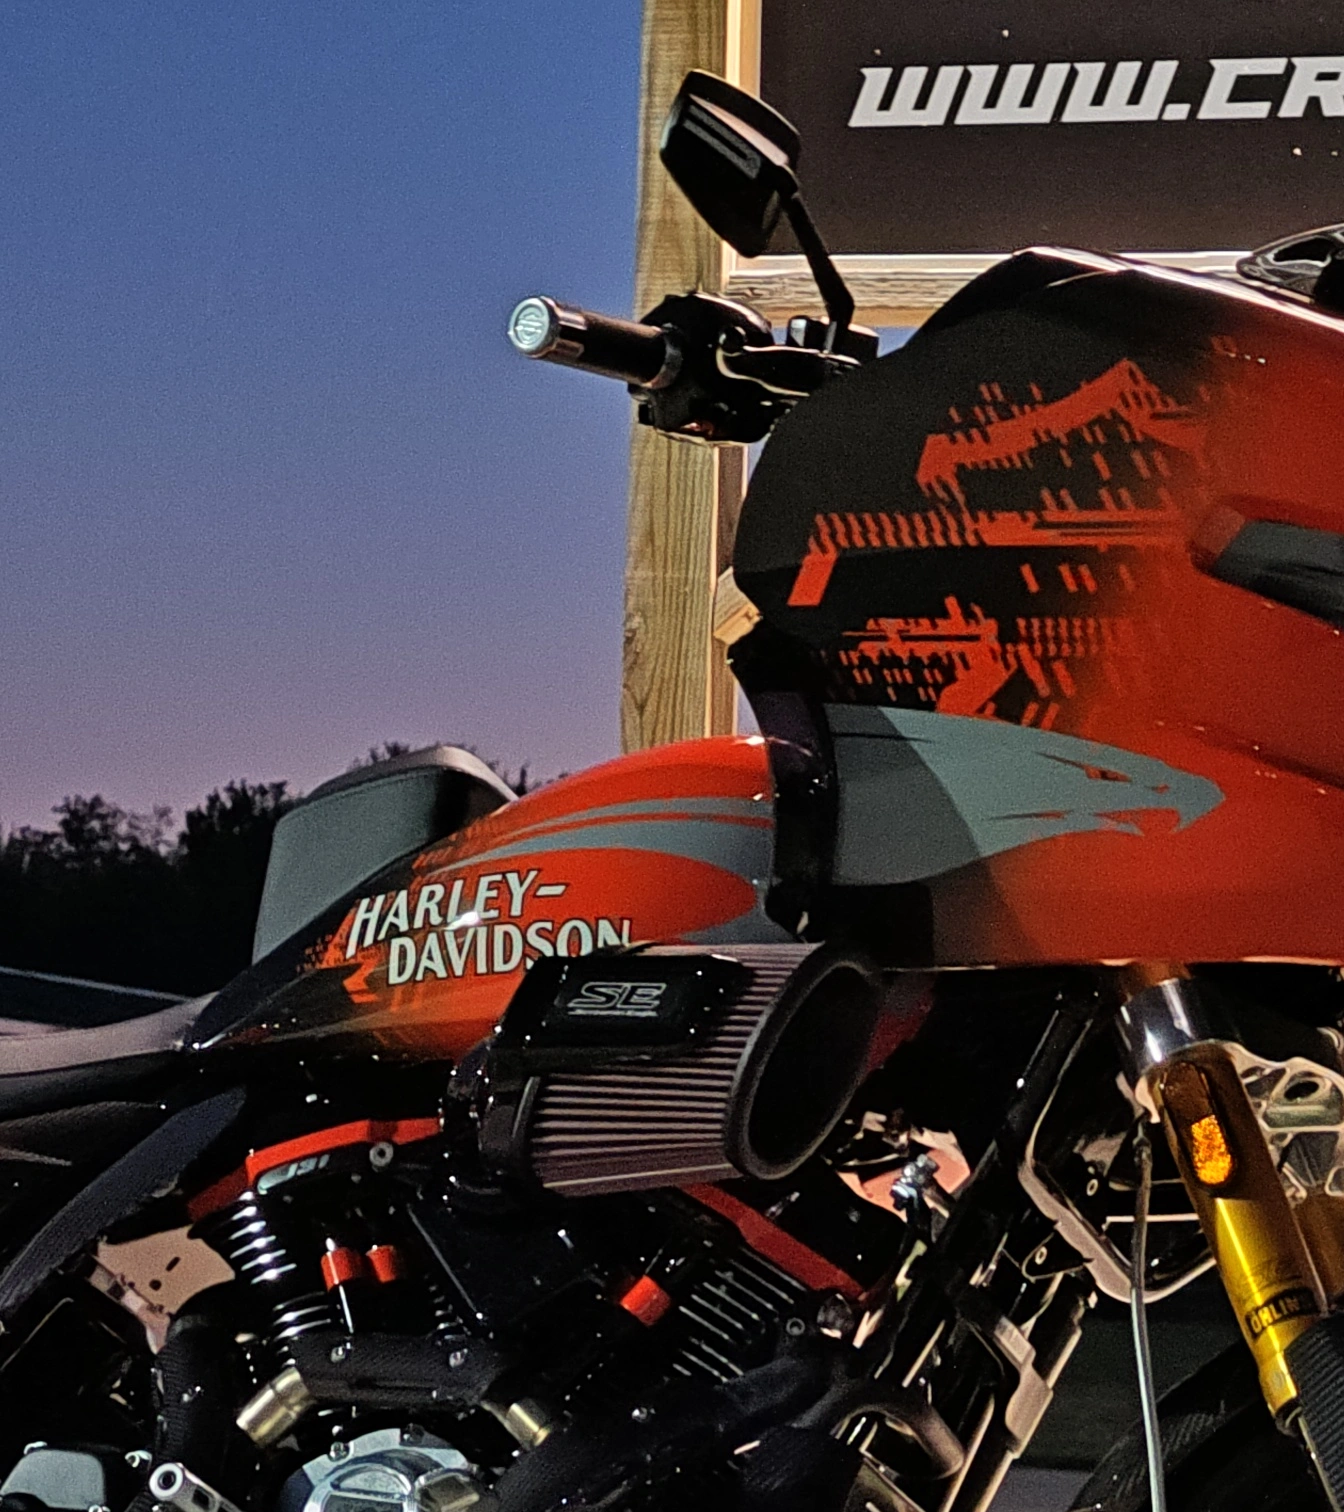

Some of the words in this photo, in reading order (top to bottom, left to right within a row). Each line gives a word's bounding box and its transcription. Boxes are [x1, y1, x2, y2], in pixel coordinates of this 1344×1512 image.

[346, 869, 568, 959] HARLEY-
[387, 917, 633, 985] DAVIDSON
[567, 981, 667, 1009] SE
